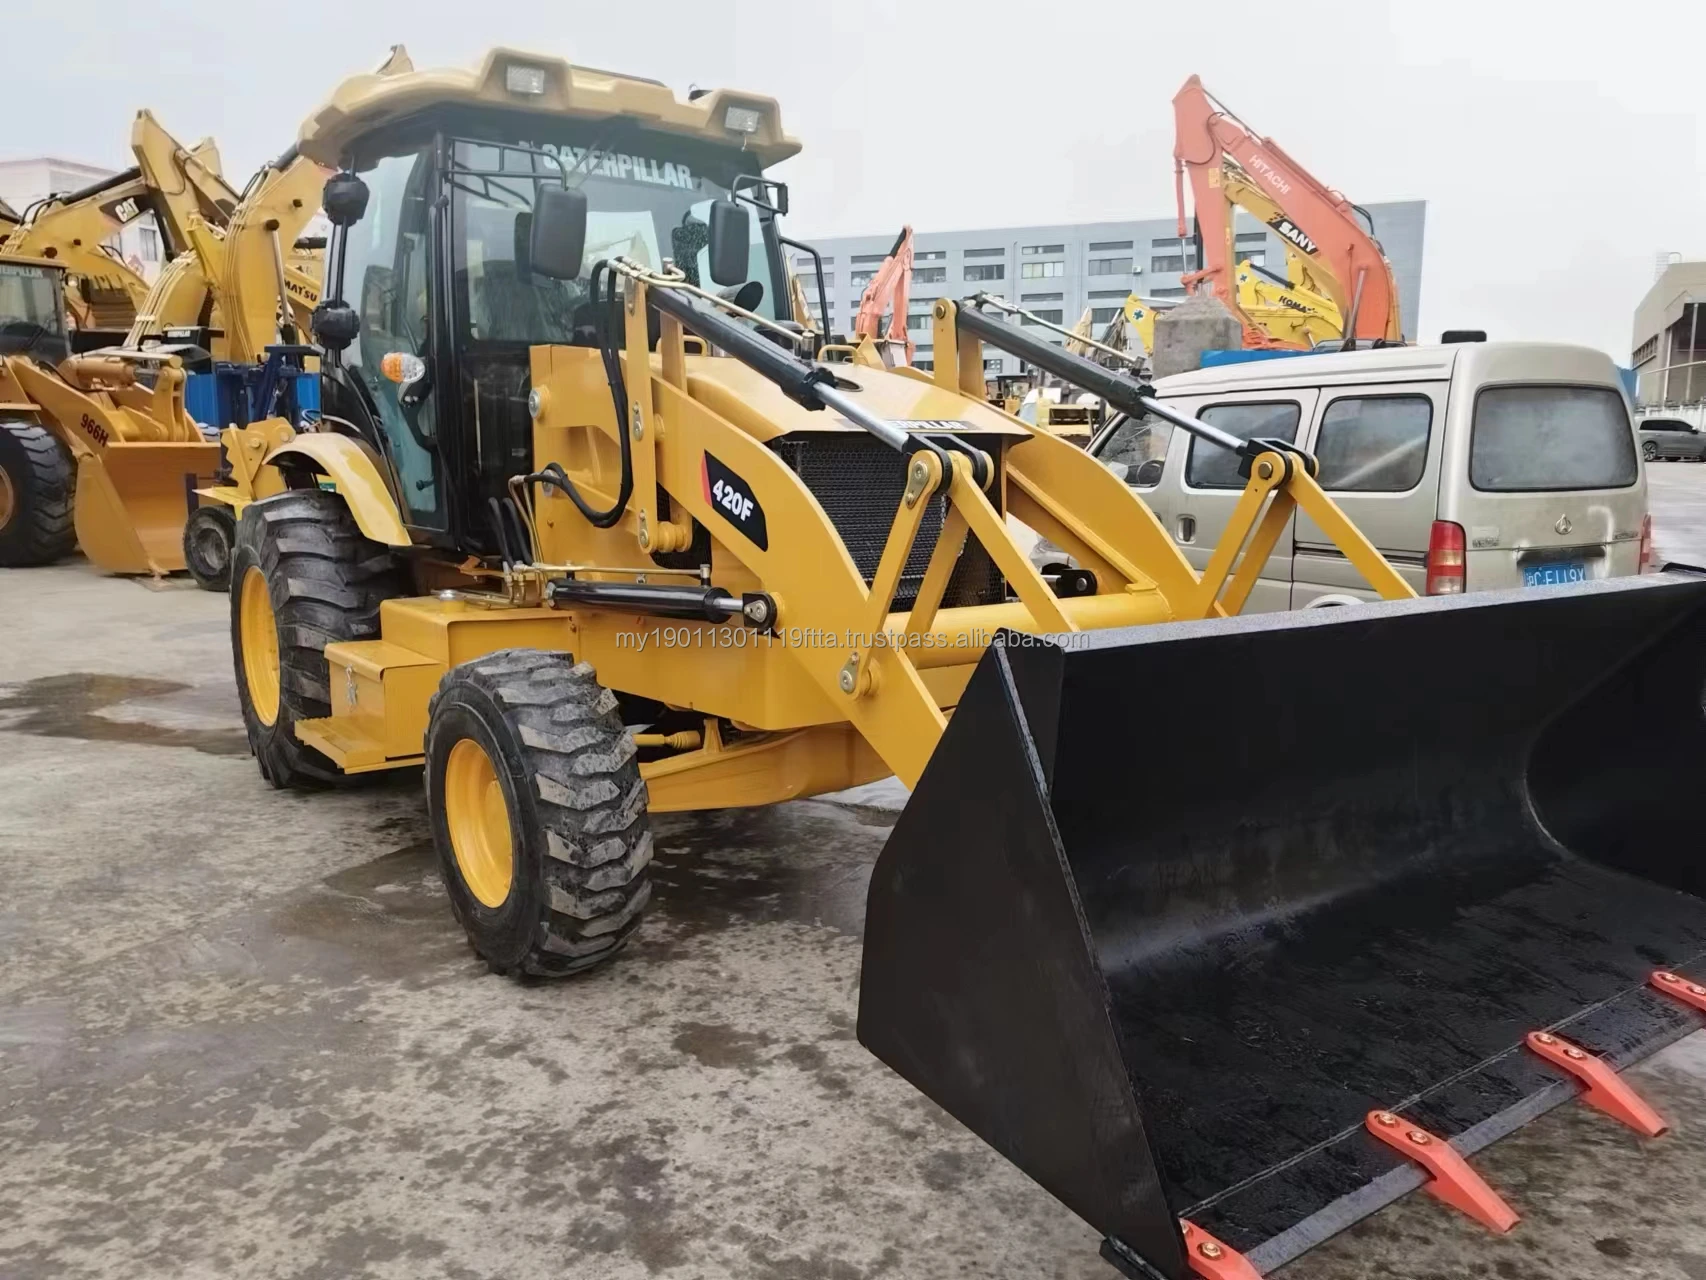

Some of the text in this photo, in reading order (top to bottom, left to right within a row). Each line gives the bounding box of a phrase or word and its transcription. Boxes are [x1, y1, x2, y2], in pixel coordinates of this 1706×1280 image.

[541, 143, 693, 189] CATERPILLAR
[1249, 154, 1292, 195] HITACHI
[115, 197, 140, 223] CAT
[1278, 221, 1318, 254] SANY
[284, 277, 318, 302] MATSU
[1279, 295, 1318, 314] KOMA
[80, 413, 109, 447] 966H
[712, 479, 754, 521] 420F
